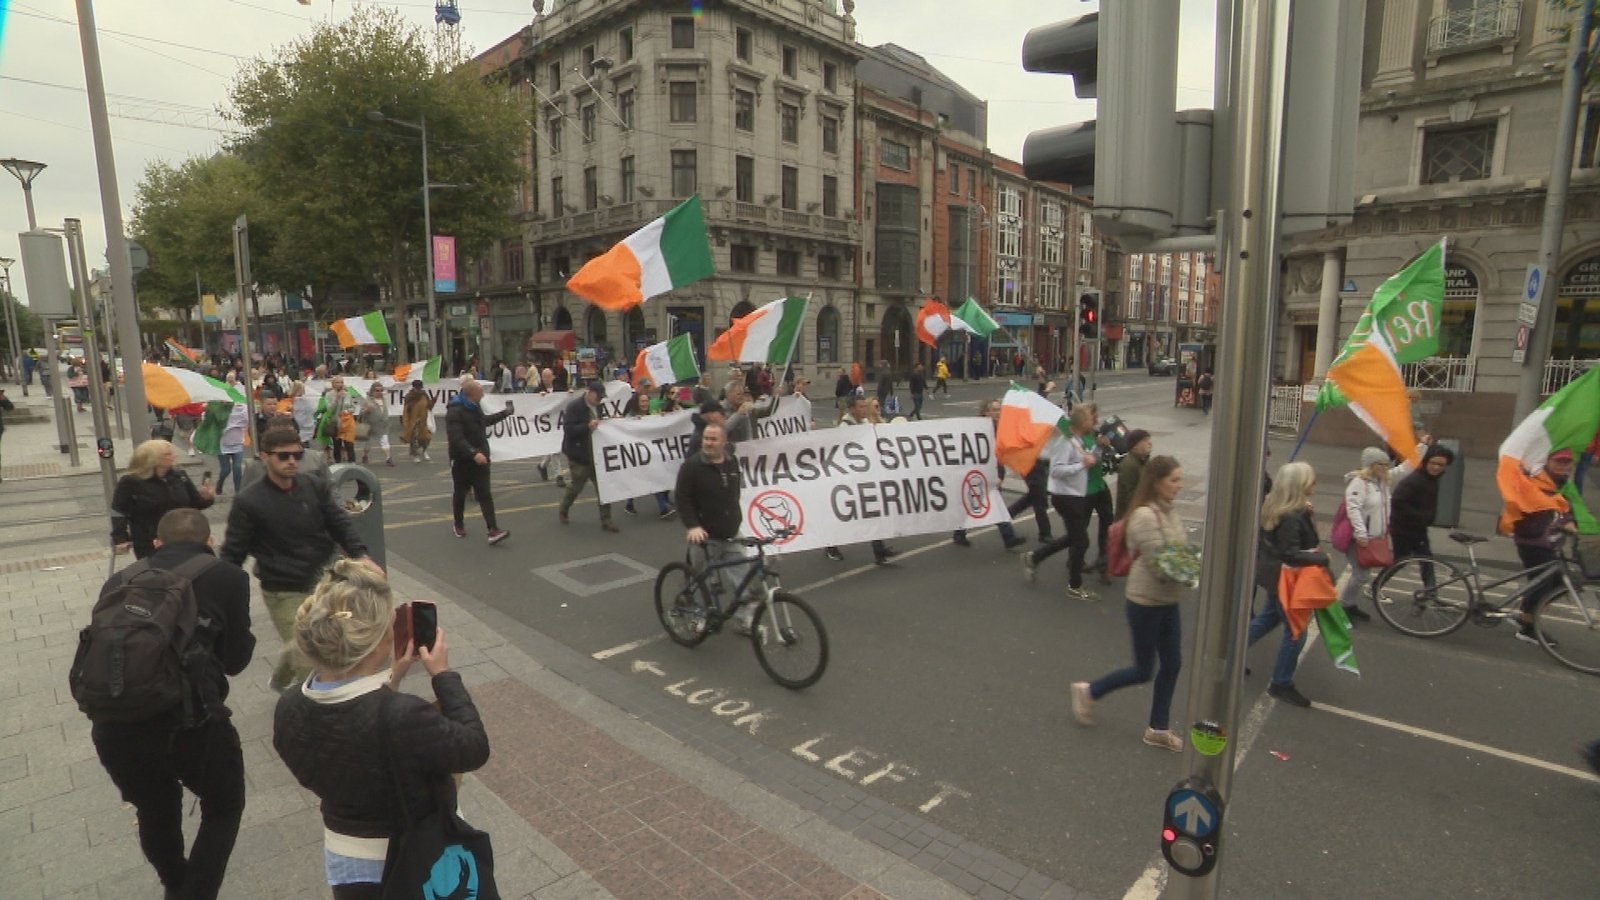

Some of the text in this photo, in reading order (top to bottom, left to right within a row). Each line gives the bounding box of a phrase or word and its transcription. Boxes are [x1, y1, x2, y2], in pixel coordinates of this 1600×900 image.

[534, 413, 551, 434] IS
[603, 442, 651, 472] END
[651, 434, 692, 462] THE
[740, 433, 990, 489] MASKS SPREAD
[831, 476, 947, 522] GERMS
[664, 678, 972, 813] LOOK LEFT
